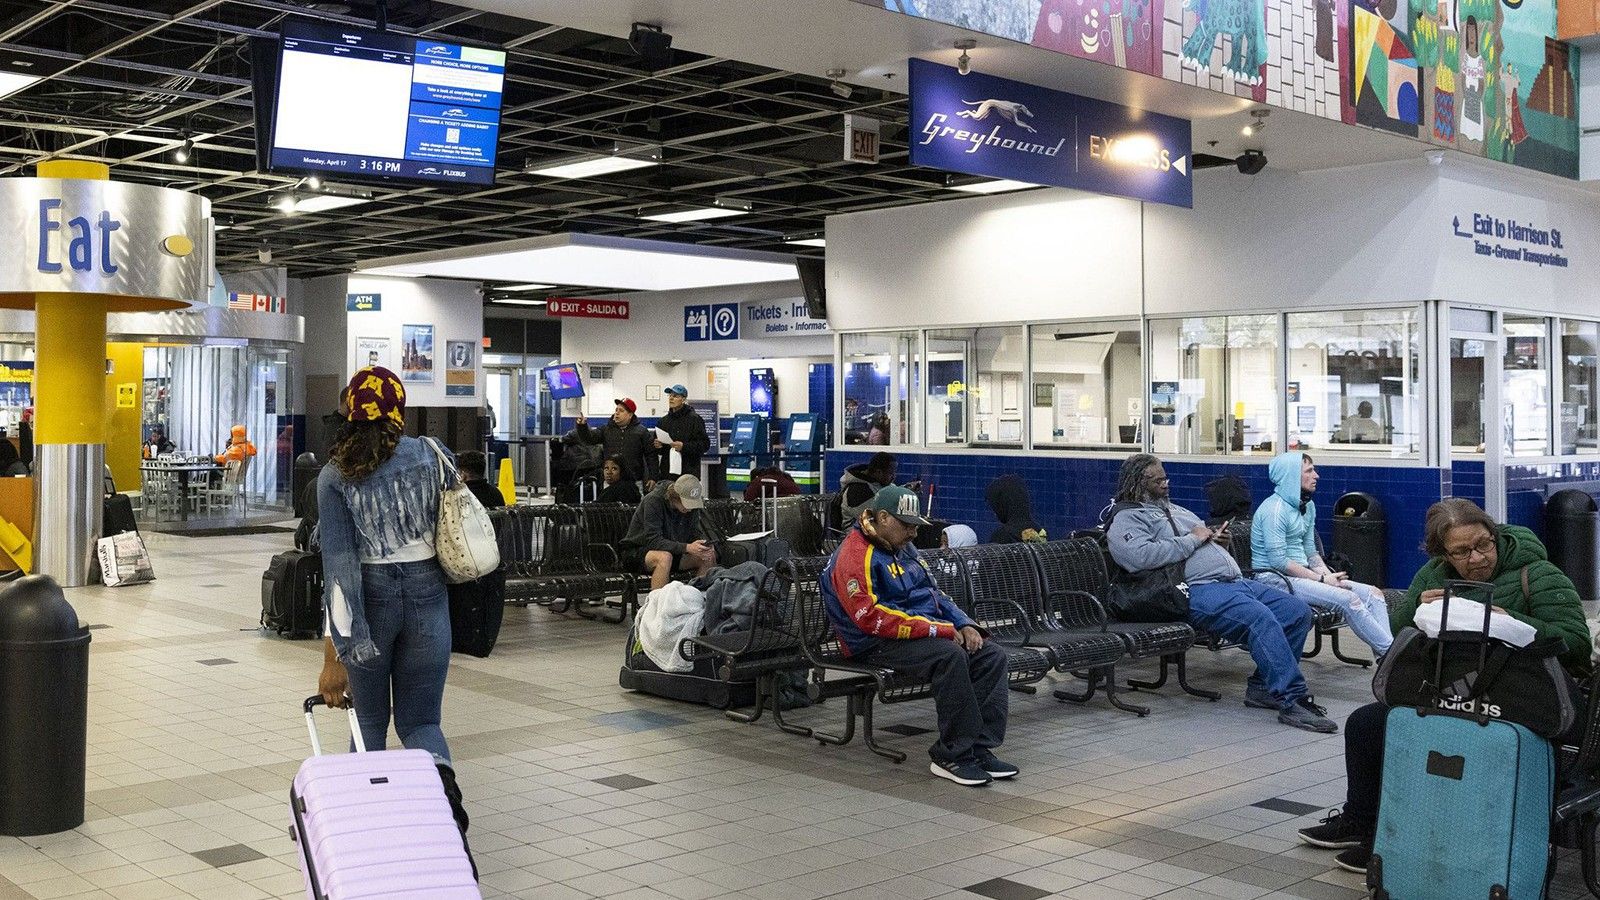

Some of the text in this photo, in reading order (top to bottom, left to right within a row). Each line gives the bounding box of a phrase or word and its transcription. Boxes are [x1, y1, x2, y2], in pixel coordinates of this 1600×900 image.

[854, 129, 875, 154] EXIT
[919, 112, 1065, 157] Greyhound
[303, 156, 326, 166] Monday,
[327, 158, 339, 167] April
[385, 161, 401, 172] PM
[37, 198, 121, 274] Eat
[1473, 212, 1564, 249] Exit to Harrison St.
[1522, 248, 1569, 267] Transportation
[354, 295, 373, 303] ATM
[561, 302, 580, 313] EXIT
[586, 304, 617, 315] SALIDA
[747, 304, 782, 320] Tickets
[766, 323, 789, 332] Boletos
